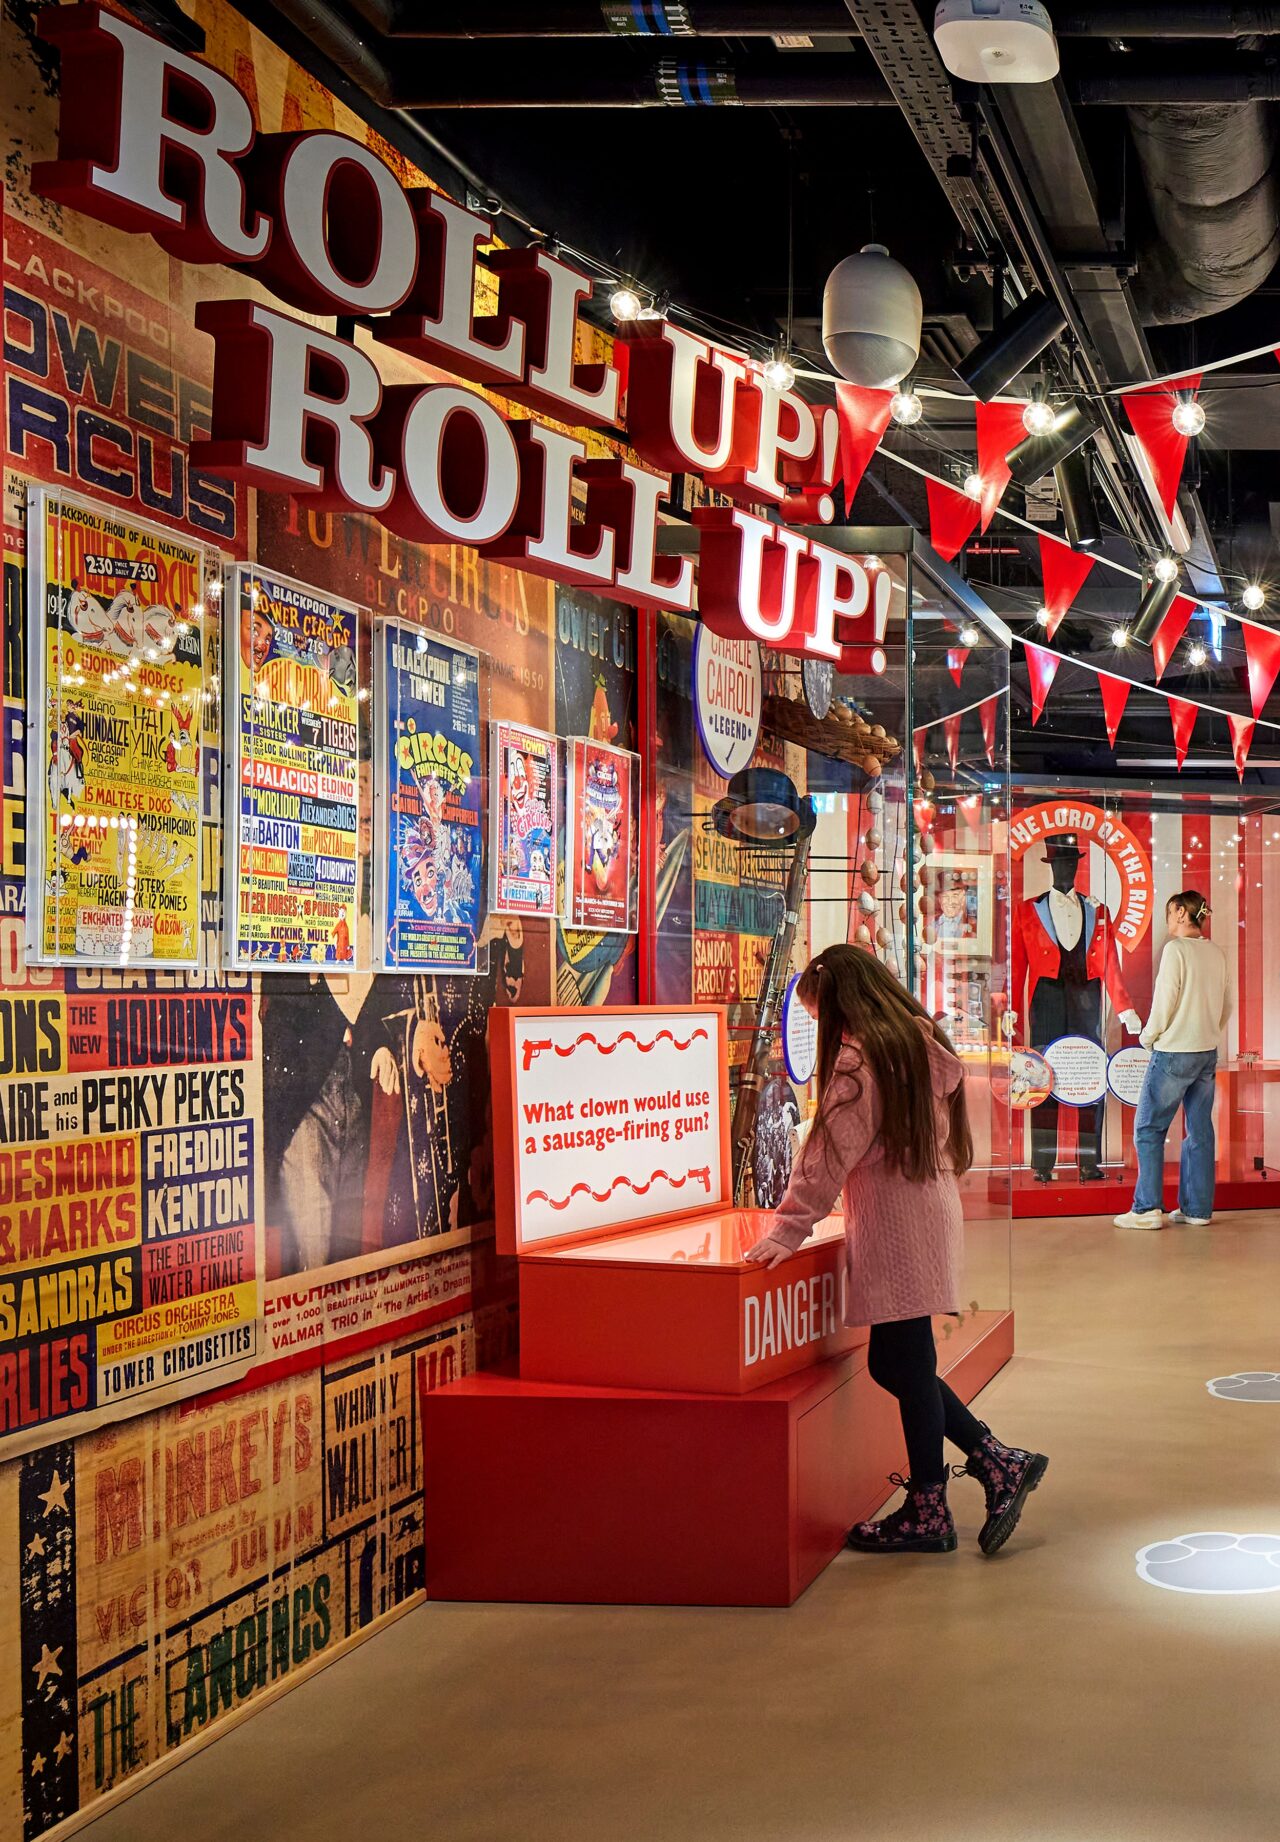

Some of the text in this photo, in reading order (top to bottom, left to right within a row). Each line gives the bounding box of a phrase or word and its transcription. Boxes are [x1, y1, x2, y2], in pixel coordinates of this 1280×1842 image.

[93, 10, 839, 525] ROLL UP!
[244, 305, 893, 675] ROLL UP!
[48, 514, 127, 602] TOWER
[103, 520, 126, 538] SHOW
[128, 530, 138, 543] OF
[142, 533, 155, 550] ALL
[159, 542, 196, 565] NATIONS
[273, 585, 330, 618] BLACKPOOL
[365, 575, 463, 637] BLACKPOOL
[253, 595, 350, 648] TOWER CIRCUS
[392, 643, 450, 685] BLACKPOOL
[711, 638, 752, 670] CHARLIE
[139, 668, 183, 693] HORSES
[409, 674, 445, 708] TOWER
[519, 667, 543, 691] 1950
[706, 660, 755, 719] CAIROLI
[334, 705, 351, 721] PAUL
[714, 714, 747, 742] LEGEND
[260, 728, 286, 741] SISTERS
[313, 717, 356, 752] 7 TIGERS
[521, 738, 545, 756] TOWER
[91, 753, 119, 766] RIDERS
[264, 742, 356, 780] LOG ROLLING ELEPHANTS
[415, 762, 455, 785] FANTASTIC
[243, 762, 354, 797] 4 PALACIOS ELDINO
[85, 785, 92, 801] 15
[96, 787, 144, 811] MALTESE
[148, 796, 172, 814] DOGS
[138, 813, 195, 837] MIDSHIPGIRLS
[337, 805, 356, 830] DOGS
[1041, 808, 1096, 831] LORD
[1097, 820, 1125, 846] OF
[72, 839, 102, 855] FAMILY
[258, 820, 299, 850] BARTON
[289, 863, 314, 879] ANGELOS
[290, 854, 313, 863] THE TWO
[316, 857, 321, 880] 4
[695, 838, 738, 876] SEVERAS
[1118, 842, 1146, 884] THE
[258, 879, 285, 891] BEAUTIFUL
[149, 893, 187, 911] 12 PONIES
[267, 893, 297, 917] HORSES
[313, 900, 339, 918] PONIES
[1118, 889, 1147, 938] RING
[83, 911, 123, 927] ENCHANTED
[271, 926, 328, 942] KICKING MULE
[695, 938, 733, 968] SANDOR
[729, 969, 736, 994] 5
[69, 1035, 102, 1055] NEW
[70, 1006, 97, 1026] THE
[107, 998, 247, 1067] HOUDINYS
[53, 1086, 78, 1106] and
[82, 1073, 168, 1135] PERKY
[174, 1069, 244, 1125] PEKES
[524, 1090, 710, 1125] What clown would use
[56, 1112, 78, 1132] his
[525, 1110, 709, 1154] a sausage-firing gun?
[0, 1125, 248, 1204] DESMOND FREDDIE
[19, 1192, 137, 1262] MARKS
[147, 1175, 249, 1239] KENTON
[148, 1245, 172, 1273] THE
[177, 1231, 244, 1266] GLITTERING
[149, 1257, 244, 1306] WATER FINALE
[273, 1317, 290, 1329] over
[327, 1290, 378, 1313] BEAUTIFULLY
[384, 1273, 430, 1296] ILLUMINATED
[434, 1258, 470, 1276] FOUNTAINS
[102, 1343, 123, 1357] UNDER
[136, 1331, 169, 1350] DIRECTION
[178, 1316, 210, 1335] TOMMY
[211, 1307, 240, 1327] JONES
[114, 1291, 236, 1341] CIRCUS ORCHESTRA
[272, 1323, 324, 1350] VALMAR
[331, 1312, 358, 1332] TRIO
[363, 1309, 372, 1320] in
[744, 1272, 836, 1367] DANGER
[104, 1326, 250, 1397] TOWER CIRCUSETTES
